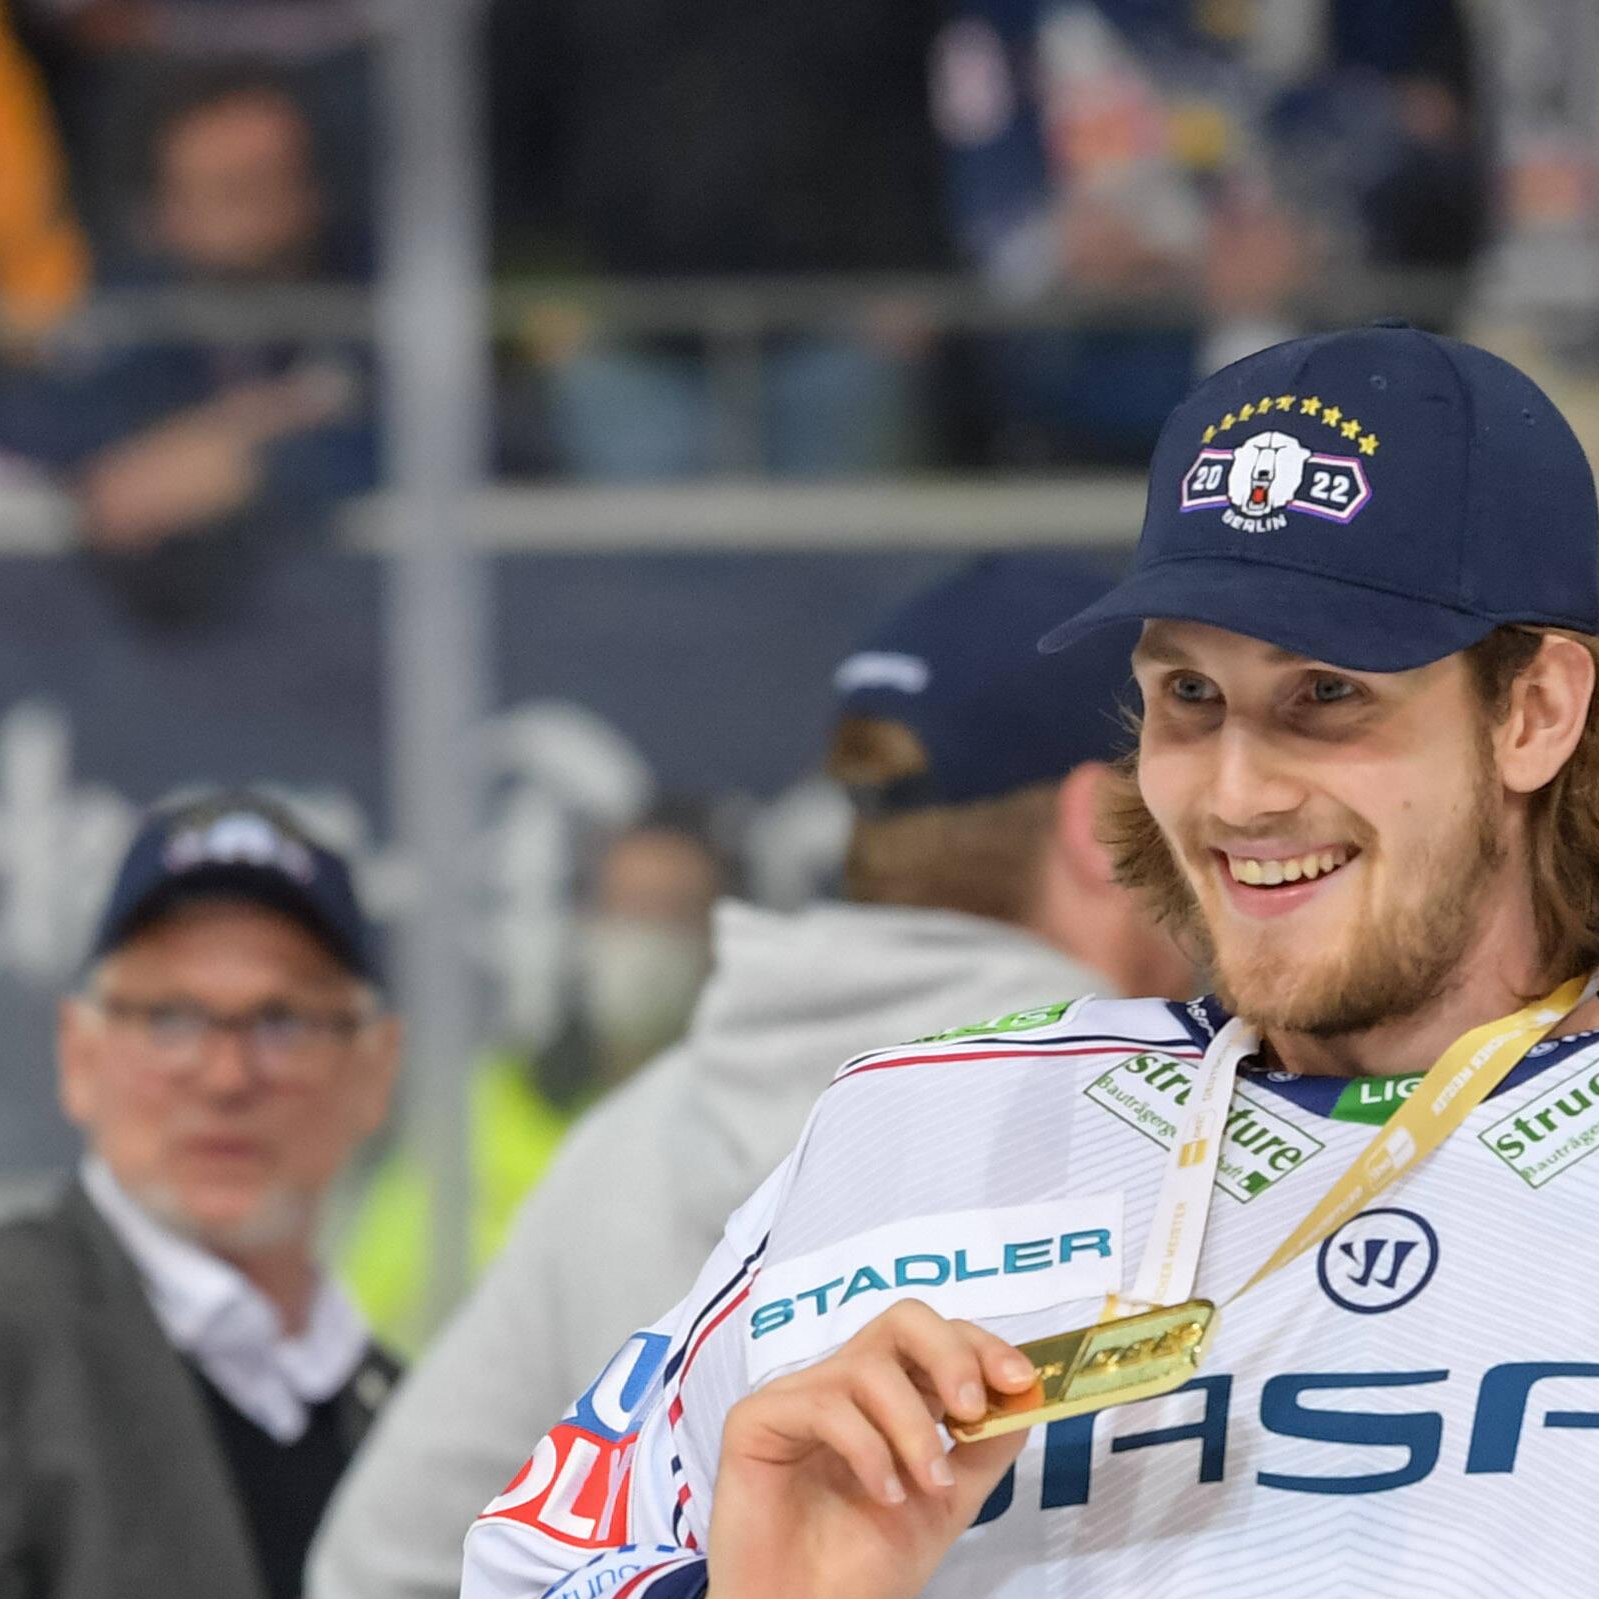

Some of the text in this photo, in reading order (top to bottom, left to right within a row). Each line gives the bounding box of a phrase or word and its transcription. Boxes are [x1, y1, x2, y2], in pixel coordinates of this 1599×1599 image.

[1191, 464, 1223, 491] 20
[1310, 471, 1350, 503] 22
[1221, 508, 1287, 533] BERLIN
[1360, 1077, 1426, 1105] LIG
[1124, 1055, 1302, 1172] strture
[750, 1228, 1112, 1340] STADLER
